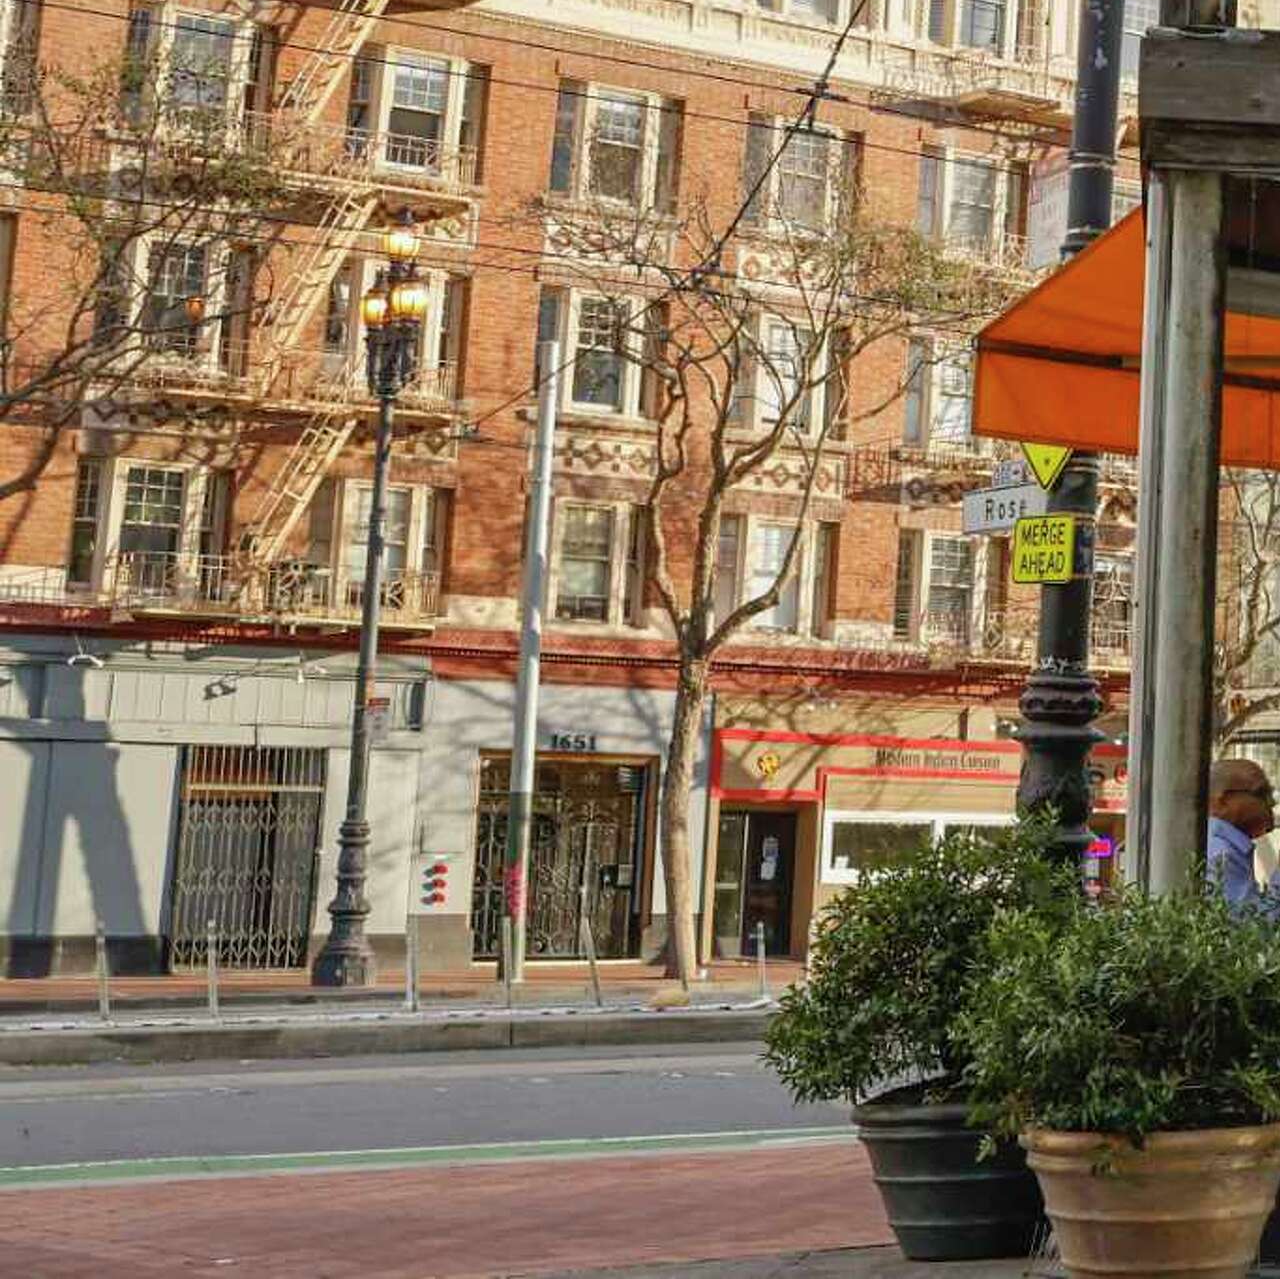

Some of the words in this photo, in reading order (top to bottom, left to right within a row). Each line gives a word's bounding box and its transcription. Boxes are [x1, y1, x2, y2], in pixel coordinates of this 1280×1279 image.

[1021, 522, 1066, 547] MERGE
[1020, 551, 1066, 576] AHEAD
[551, 733, 596, 751] 1651
